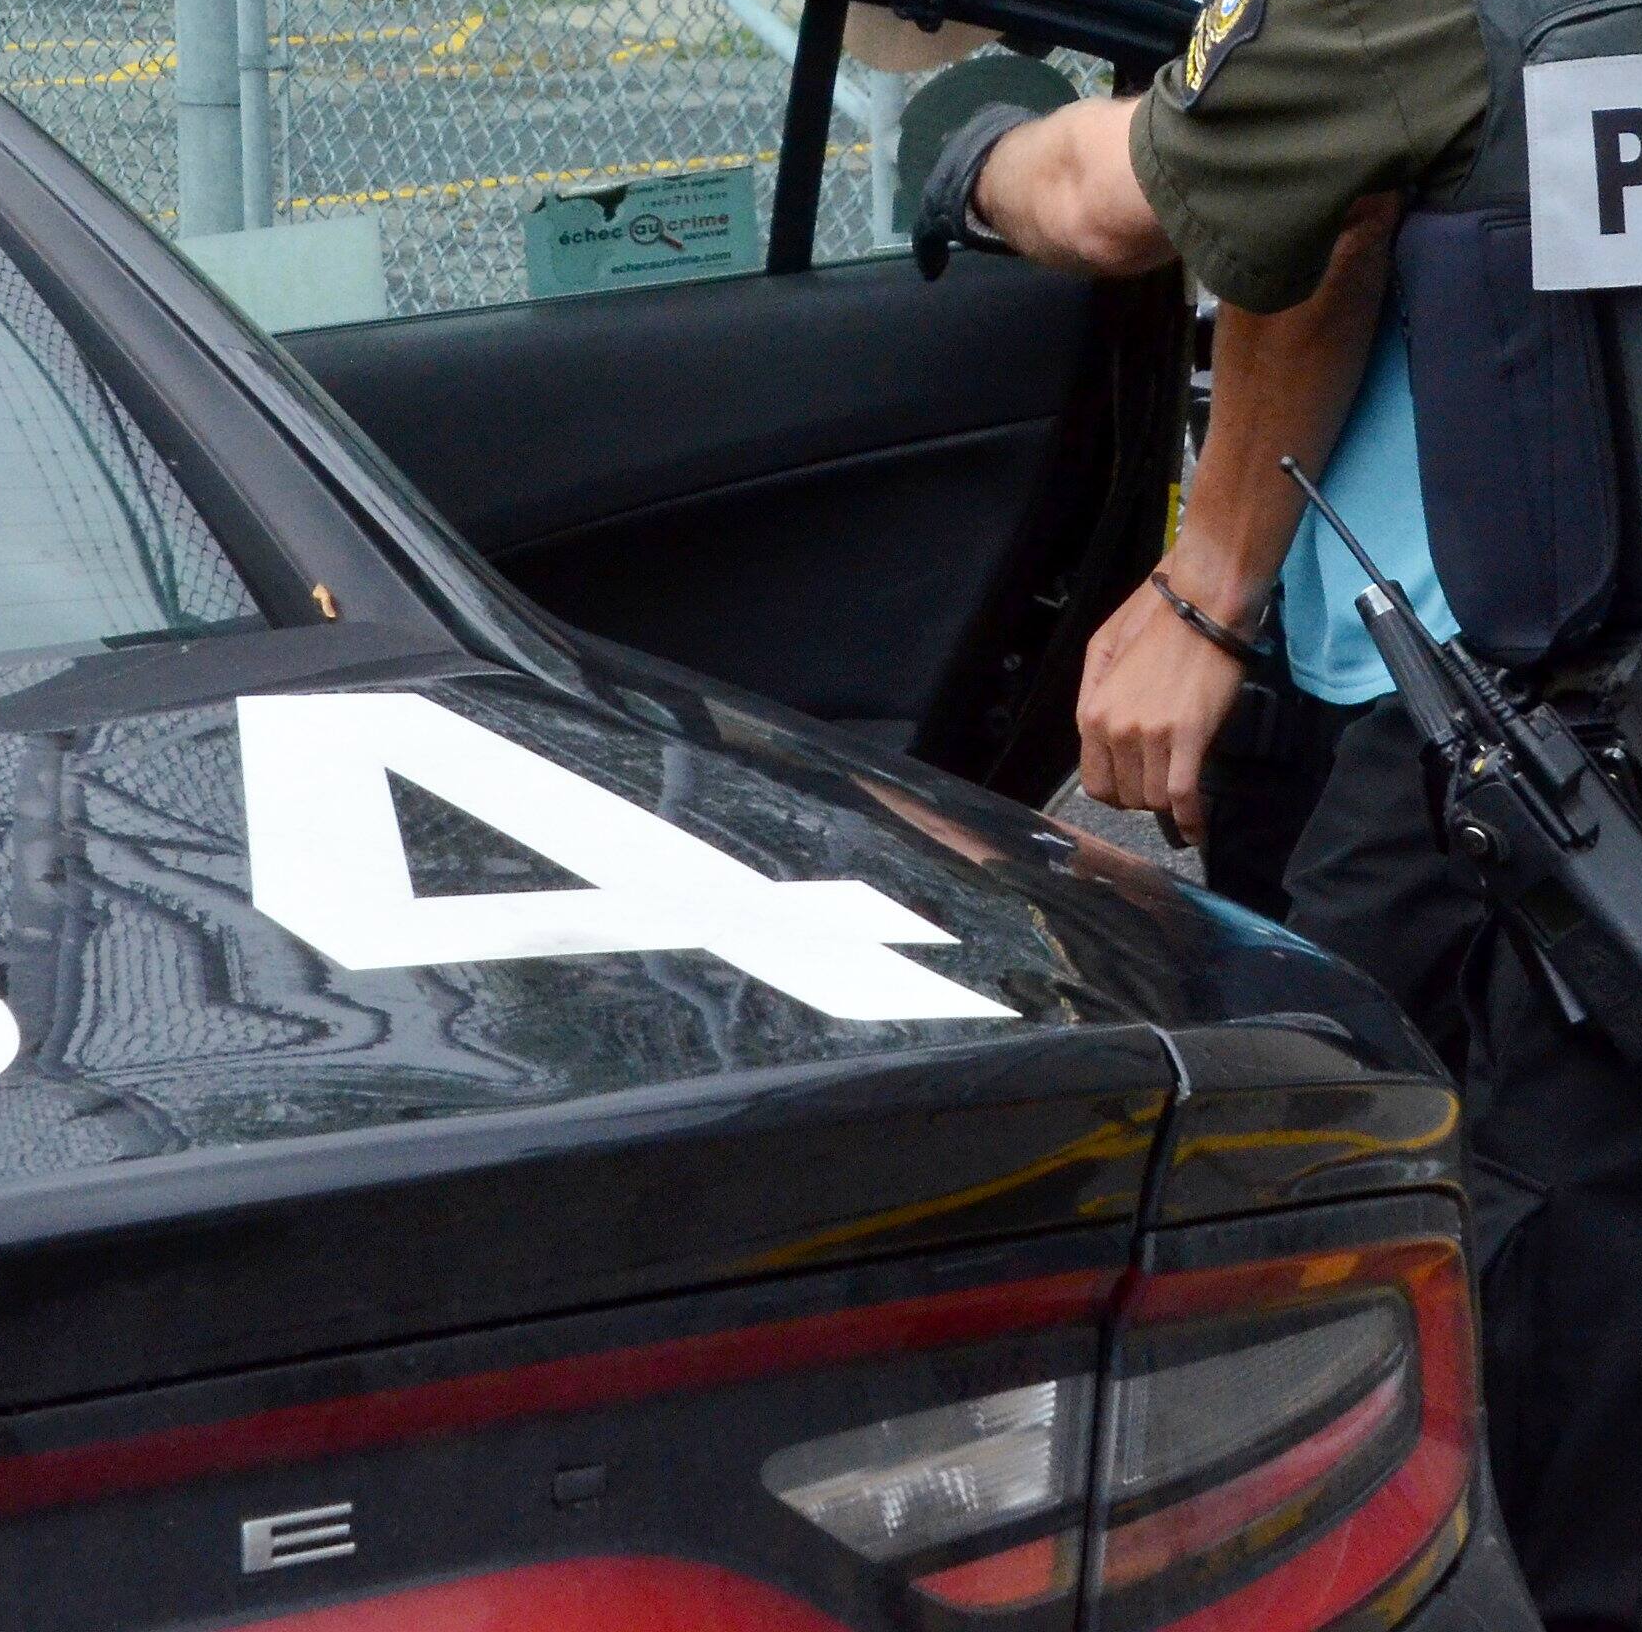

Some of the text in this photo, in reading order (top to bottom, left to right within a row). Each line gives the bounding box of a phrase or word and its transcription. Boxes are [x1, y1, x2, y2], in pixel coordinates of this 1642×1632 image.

[559, 213, 730, 246] échec au crime
